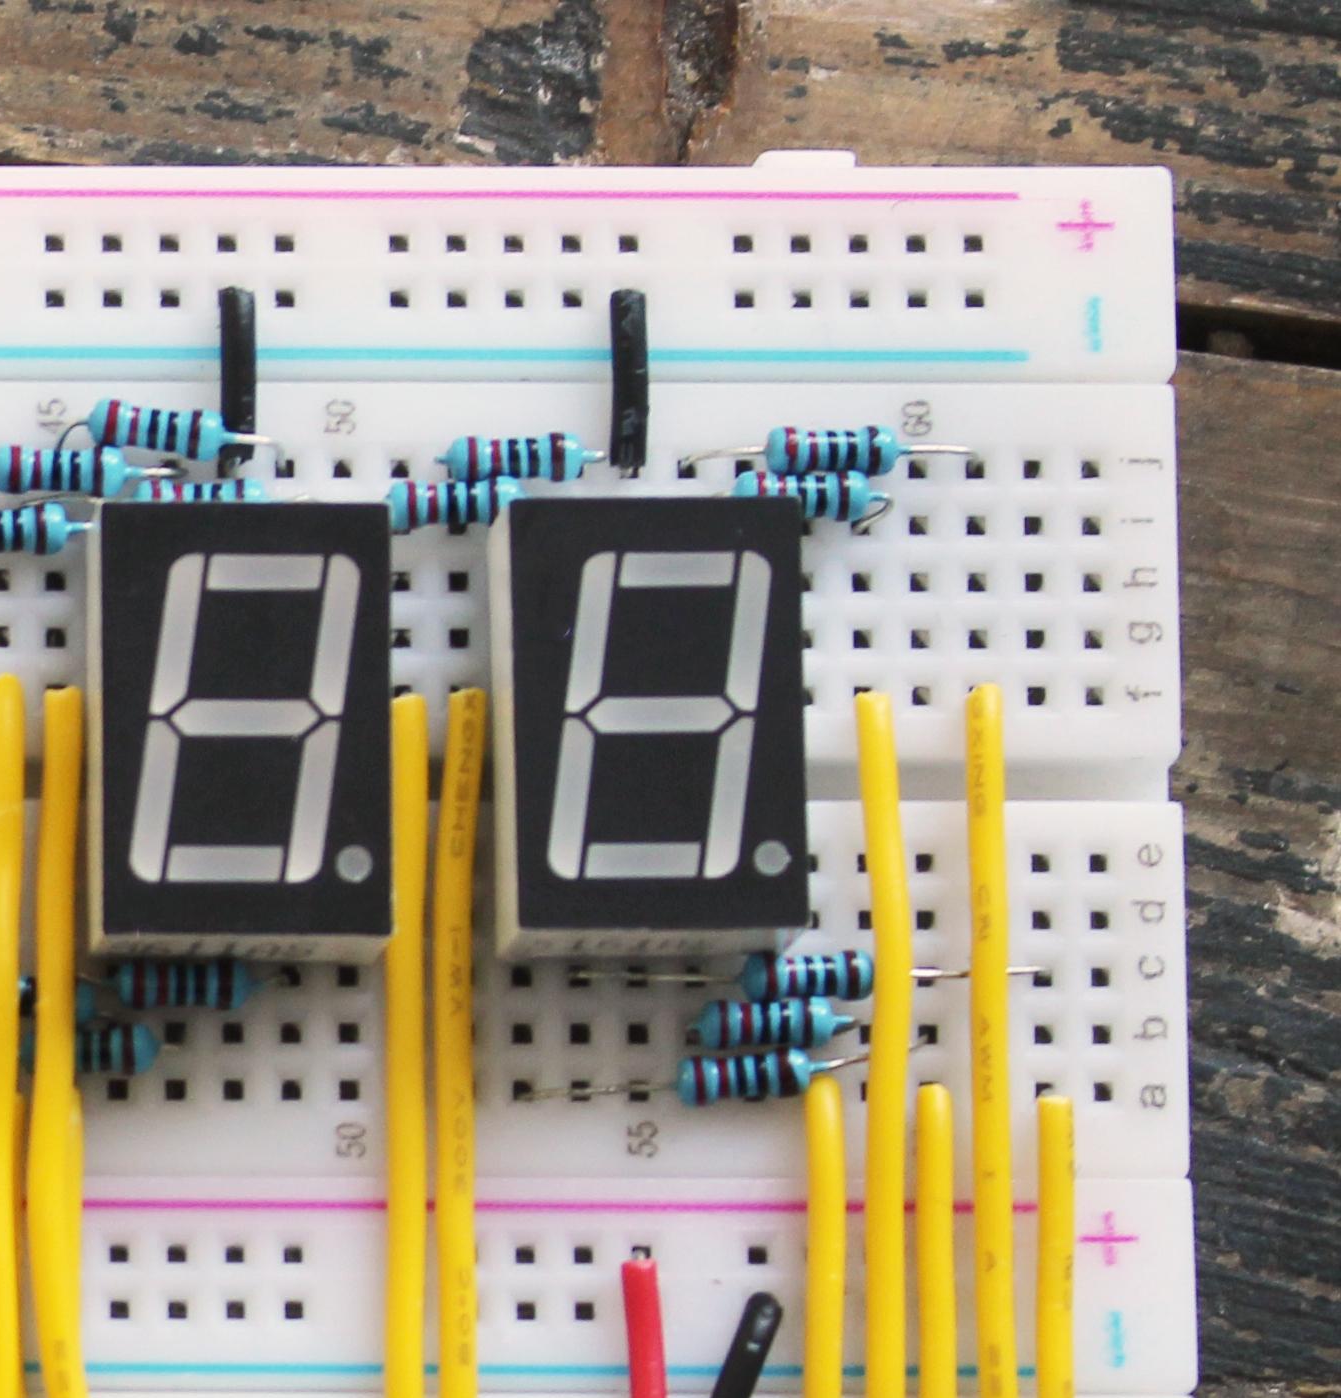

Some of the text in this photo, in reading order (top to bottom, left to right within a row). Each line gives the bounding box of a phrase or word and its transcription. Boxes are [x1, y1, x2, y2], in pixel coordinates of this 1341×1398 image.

[323, 399, 357, 436] 50
[901, 400, 933, 438] 60
[1121, 567, 1158, 590] h
[1127, 620, 1163, 646] g
[1136, 843, 1164, 869] e
[1130, 899, 1167, 925] d
[1137, 955, 1165, 981] c
[1132, 1015, 1168, 1042] b
[1138, 1084, 1167, 1110] a
[335, 1122, 368, 1159] 50
[626, 1114, 662, 1158] 55
